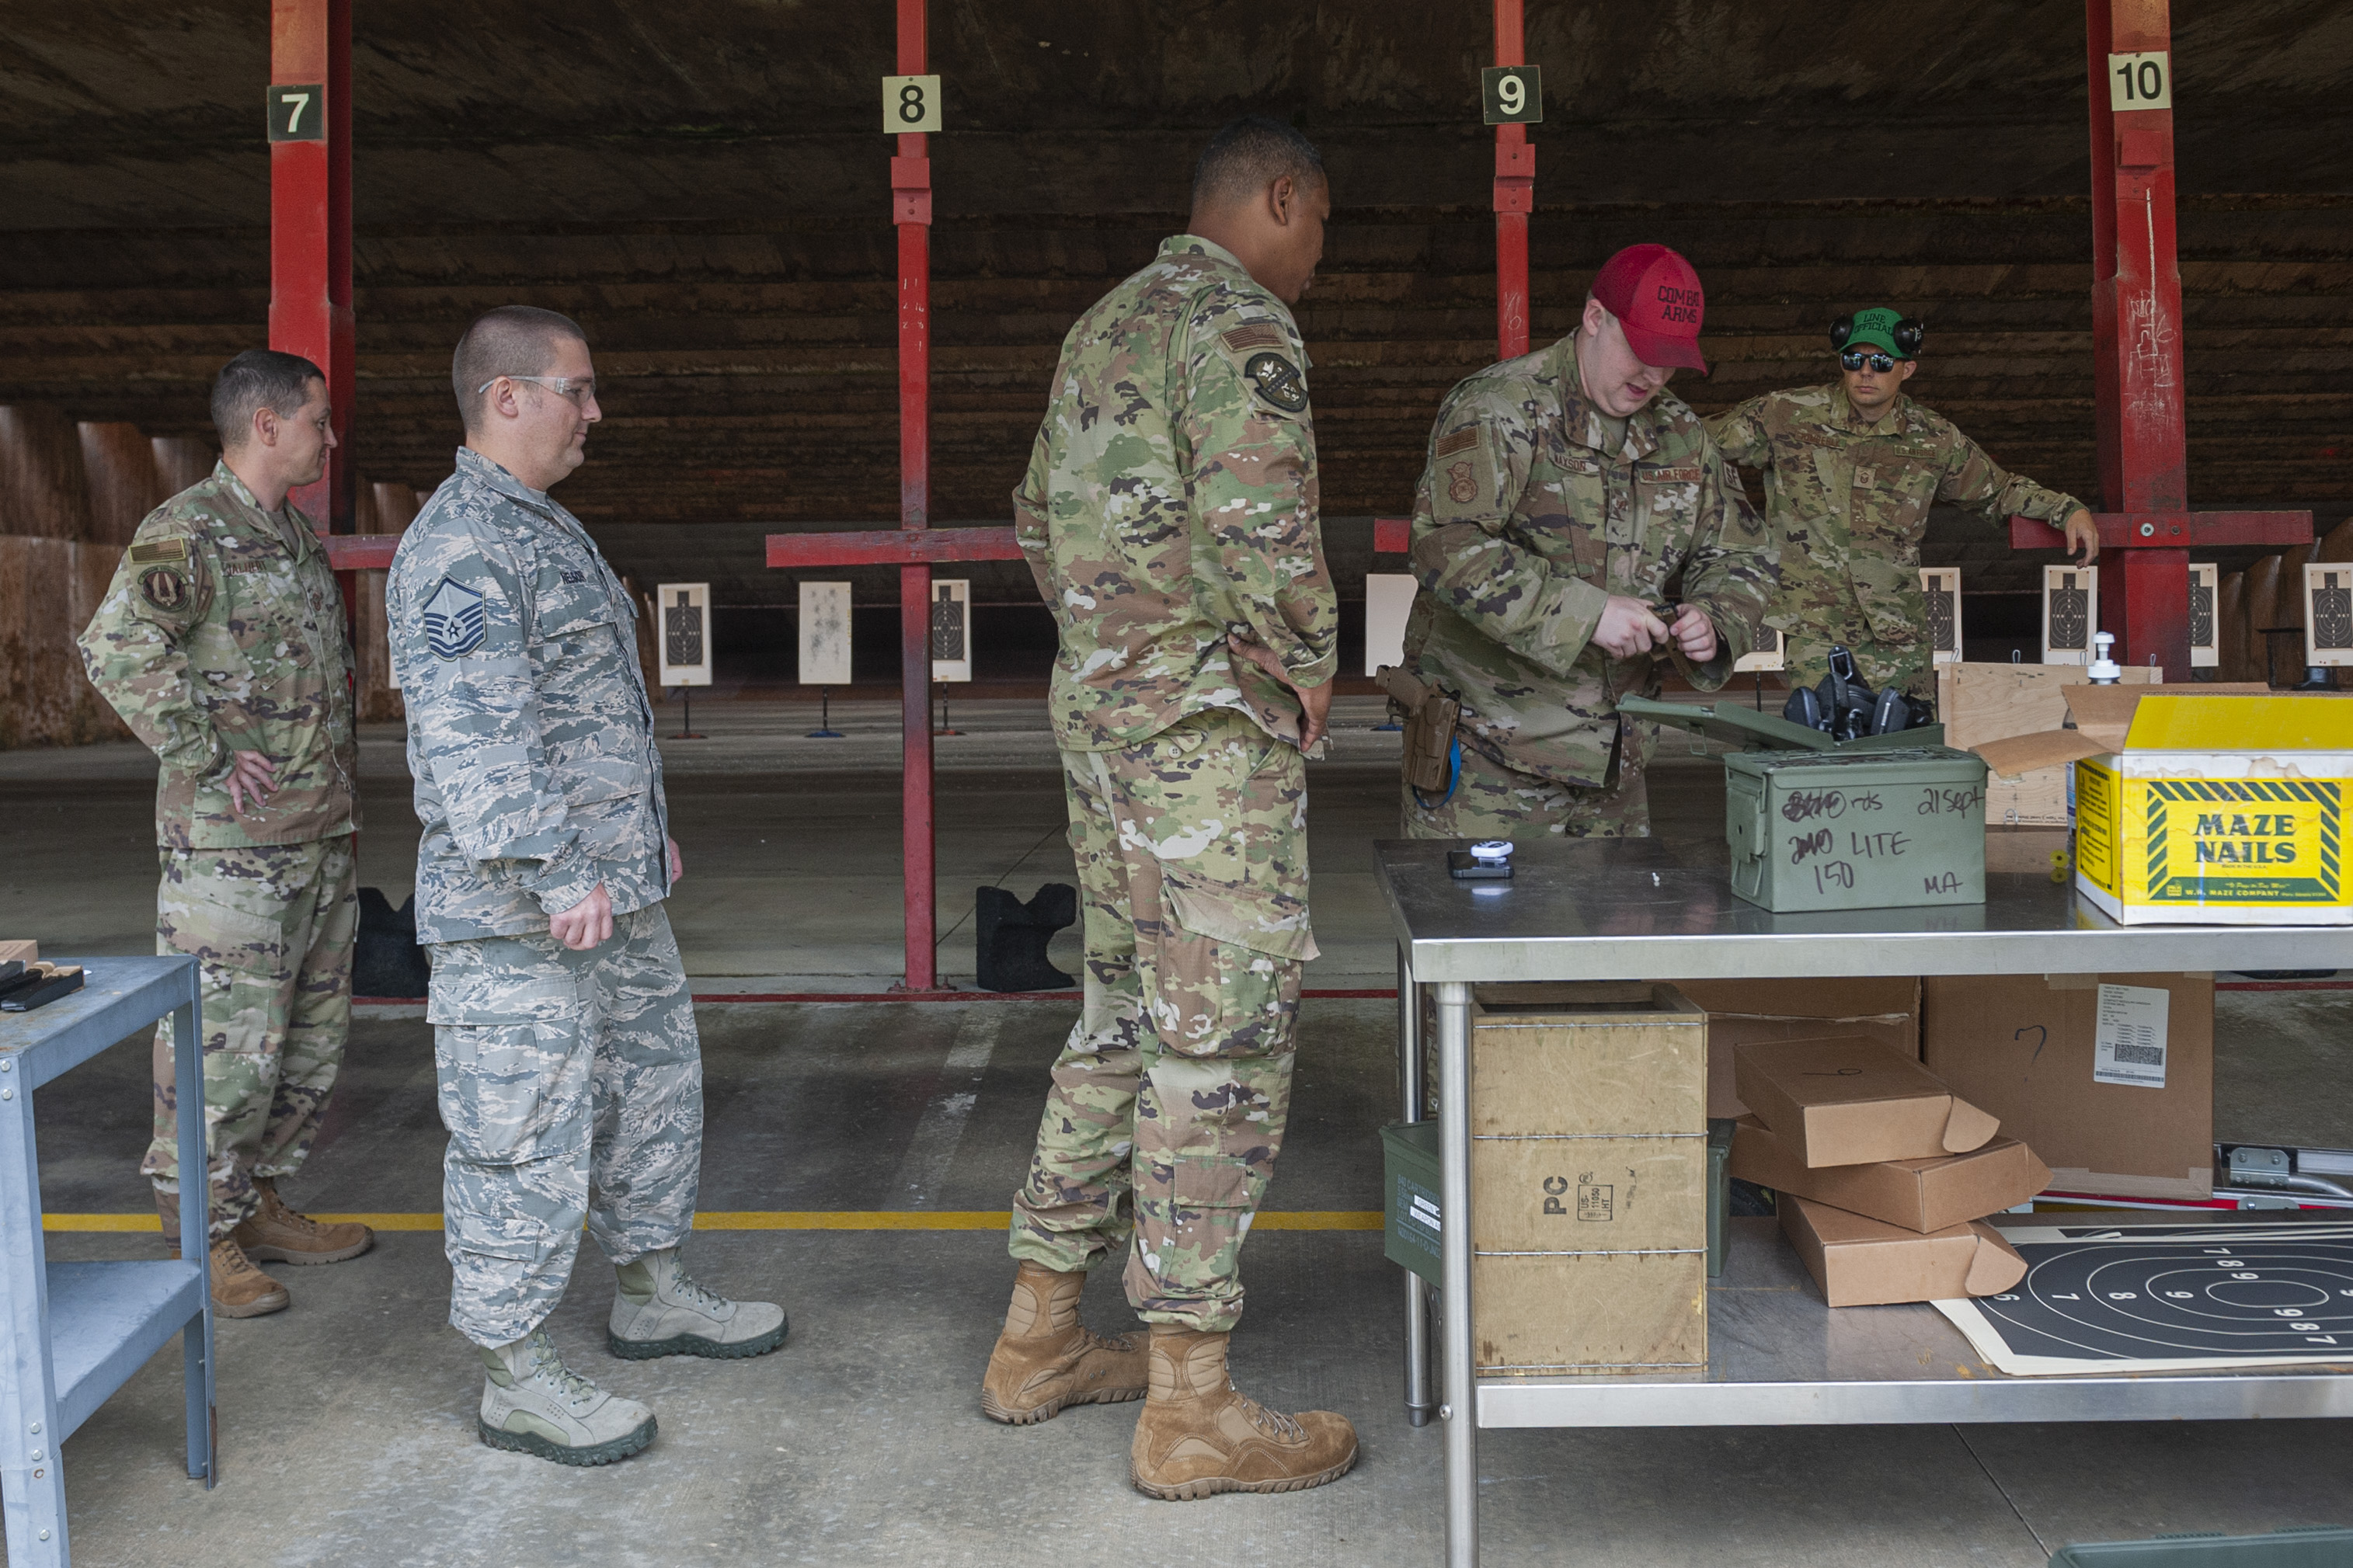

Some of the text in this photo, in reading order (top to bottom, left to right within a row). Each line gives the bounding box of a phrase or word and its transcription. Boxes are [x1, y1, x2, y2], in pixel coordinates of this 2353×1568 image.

[2117, 61, 2162, 100] 10
[899, 85, 925, 123] 8
[1498, 75, 1526, 115] 9
[281, 93, 309, 133] 7
[1661, 304, 1697, 323] ARMS
[1863, 313, 1886, 324] LINE
[1854, 322, 1894, 336] OFFICIAL
[1641, 468, 1701, 481] US AIR FORCE
[2193, 814, 2296, 836] MAZE
[1851, 831, 1912, 858] LITE
[2195, 841, 2297, 864] NAILS
[1814, 860, 1854, 894] 150
[1543, 1176, 1568, 1215] PC
[1591, 1187, 1600, 1209] 11050
[1602, 1198, 1610, 1209] HT
[2108, 1291, 2138, 1300] 8
[2289, 1323, 2320, 1331] 8
